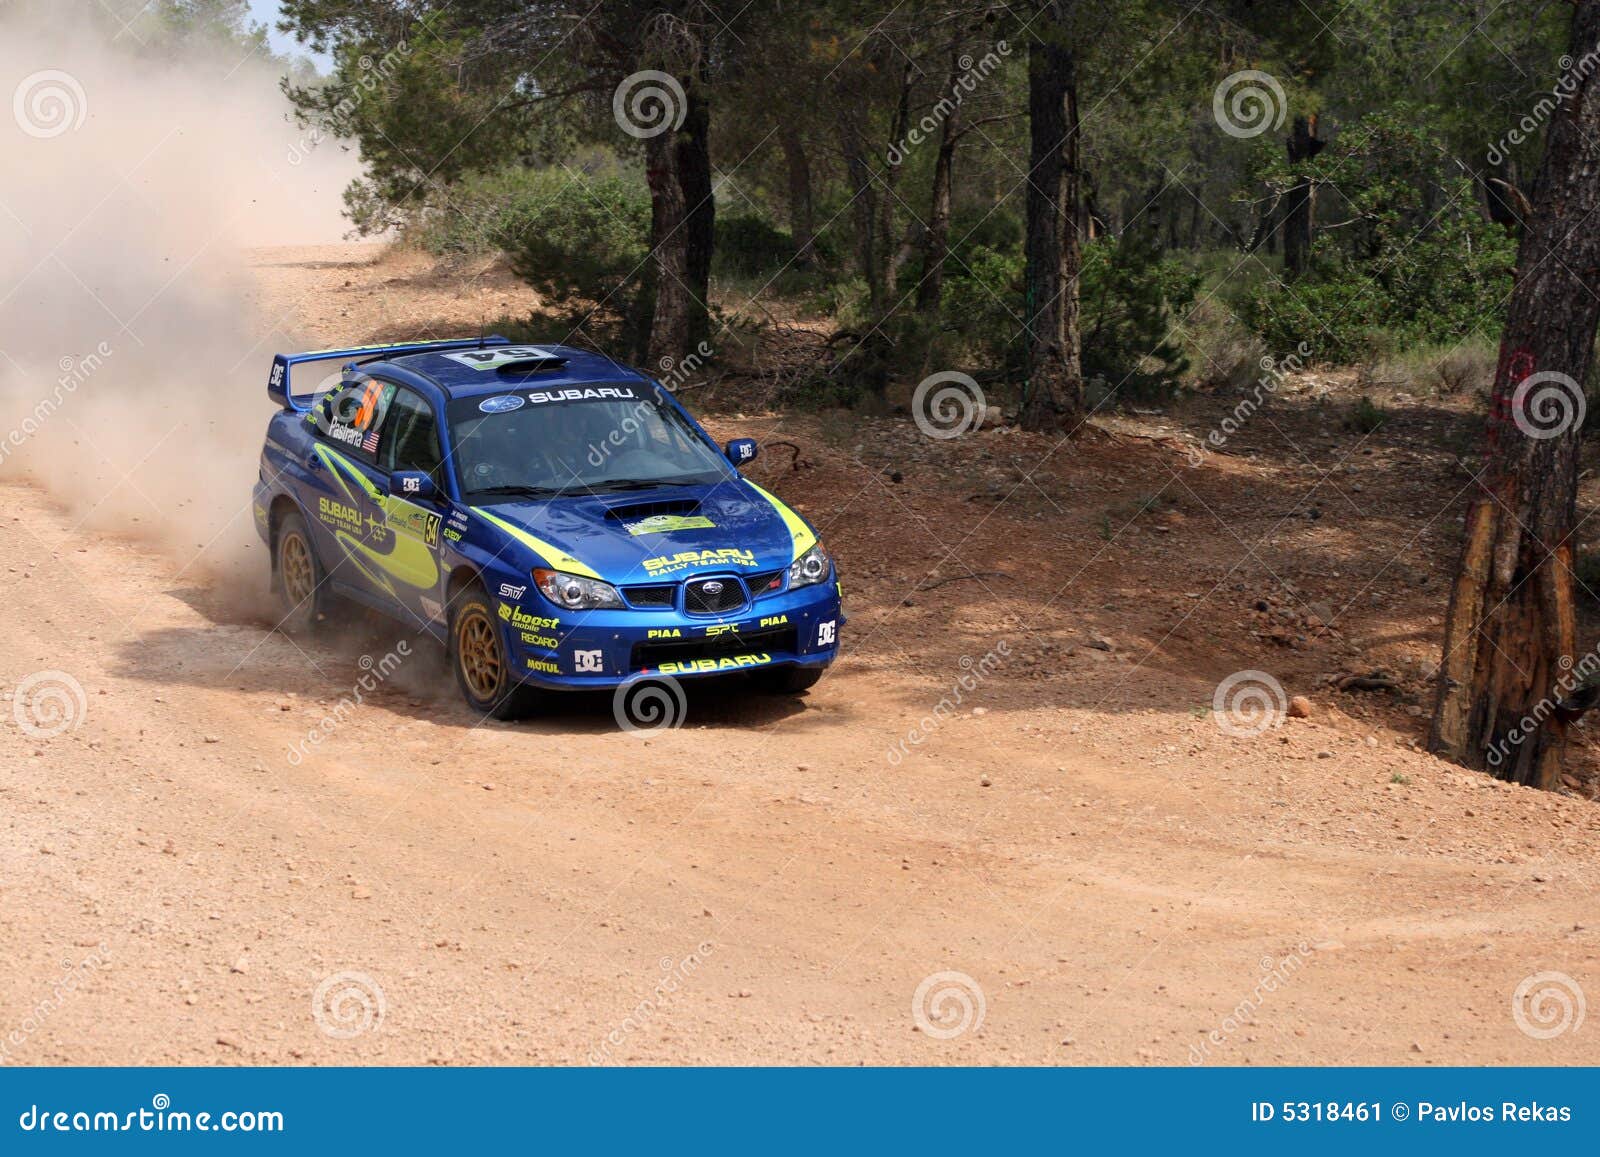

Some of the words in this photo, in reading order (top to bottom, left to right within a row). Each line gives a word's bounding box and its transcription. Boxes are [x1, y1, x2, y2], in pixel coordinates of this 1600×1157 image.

[328, 415, 363, 447] Pastrana
[319, 497, 362, 527] SUBARU
[426, 515, 440, 545] 54
[642, 548, 754, 571] SUBARU
[648, 562, 689, 578] RALLY
[691, 558, 730, 568] TEAM
[732, 558, 759, 568] USA
[511, 620, 540, 633] mobile
[512, 606, 560, 629] boost
[760, 615, 788, 628] PIAA
[521, 632, 559, 649] RECARO
[647, 629, 682, 639] PIAA
[527, 658, 560, 673] MOTUL
[658, 653, 772, 675] SUBARU
